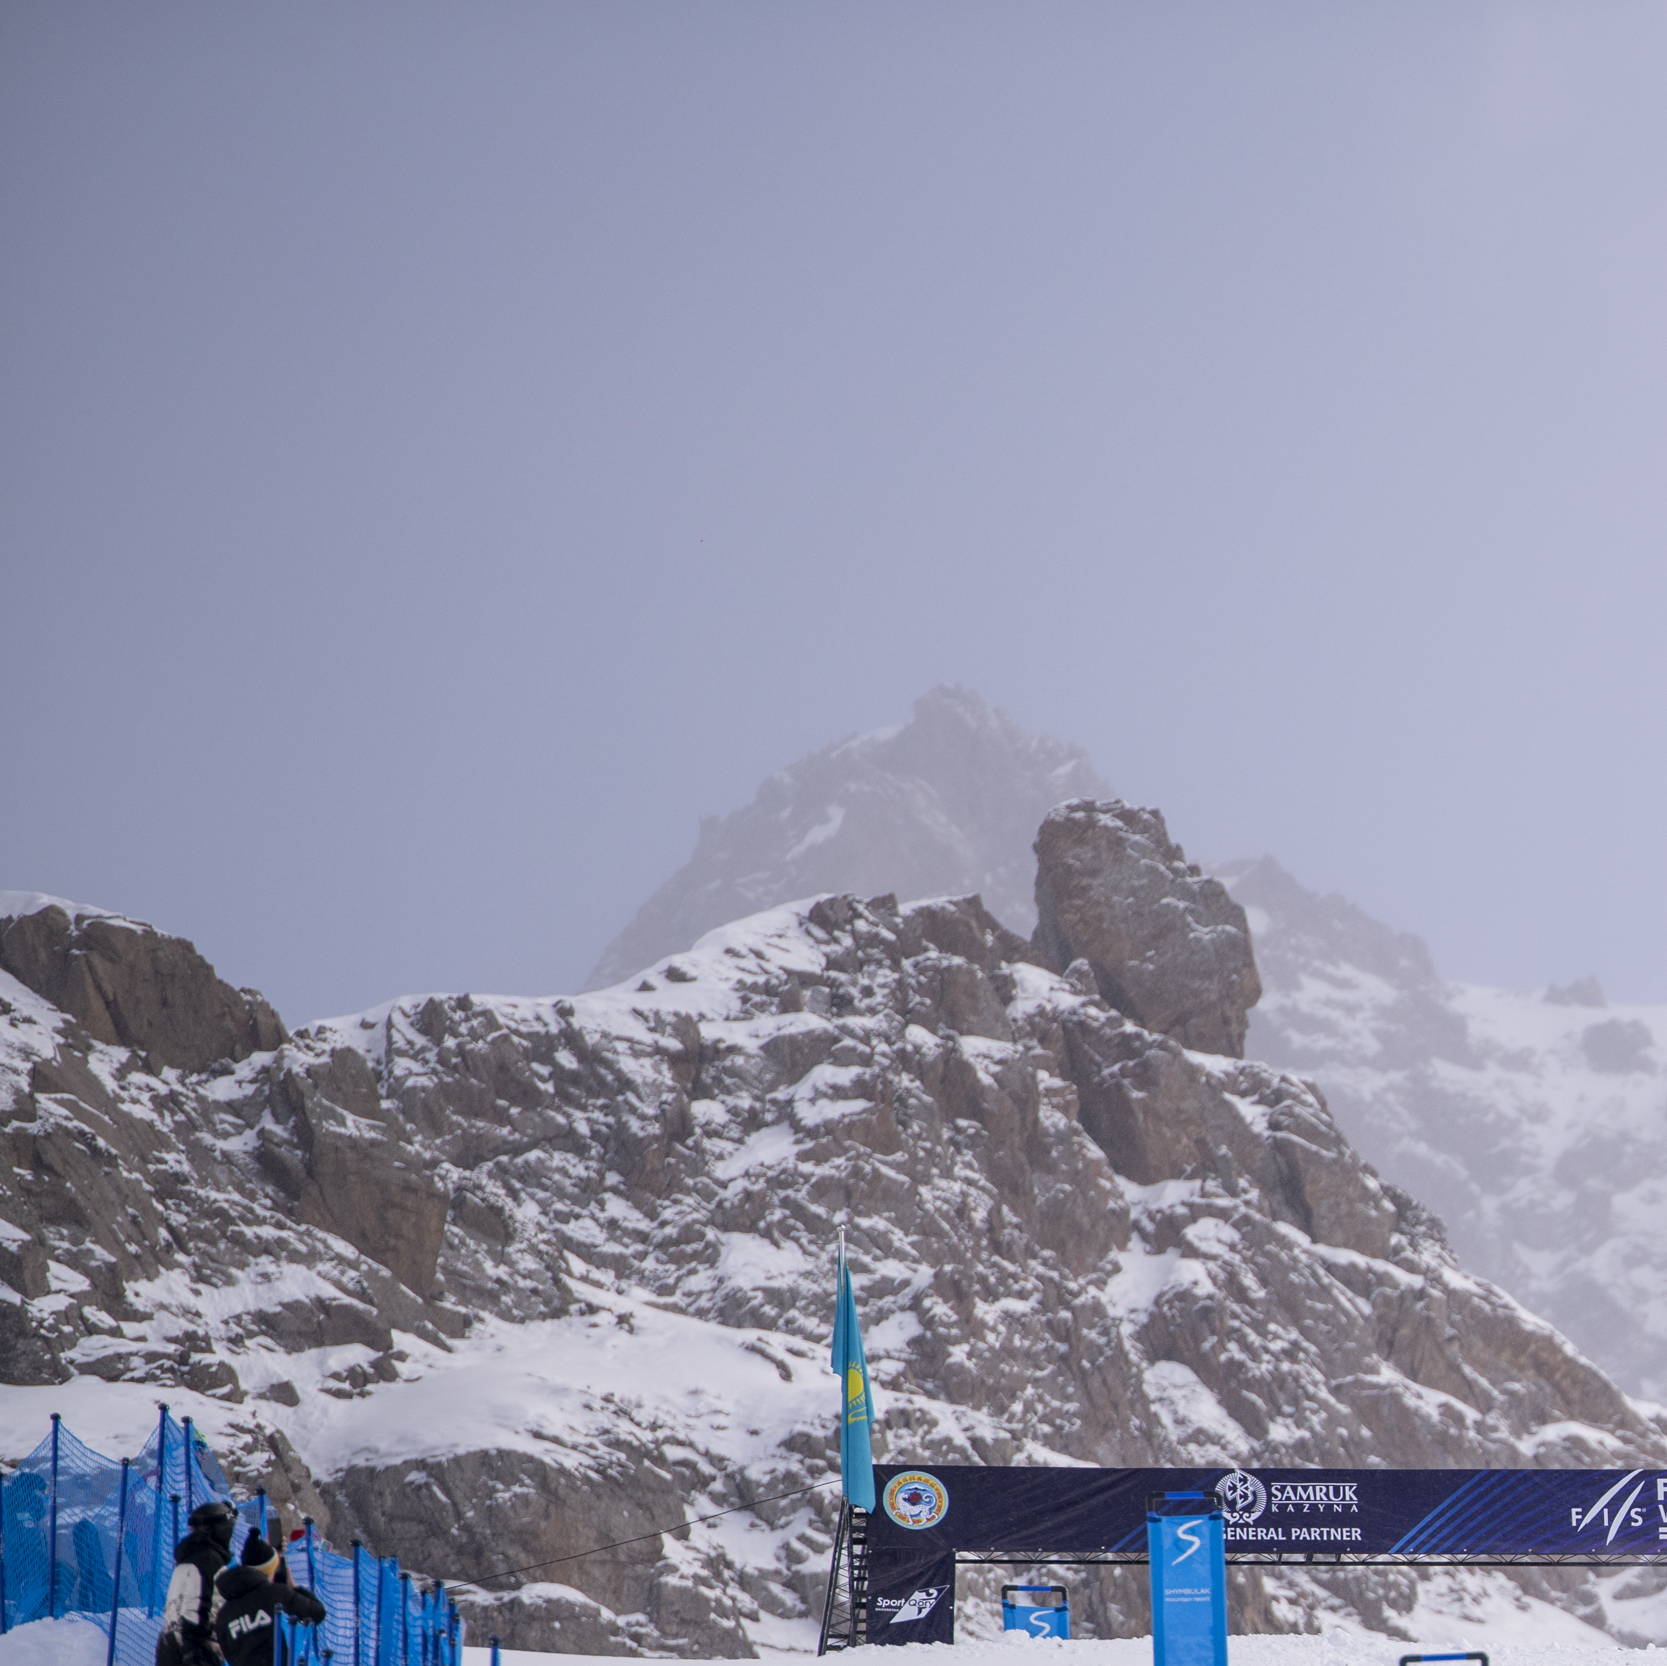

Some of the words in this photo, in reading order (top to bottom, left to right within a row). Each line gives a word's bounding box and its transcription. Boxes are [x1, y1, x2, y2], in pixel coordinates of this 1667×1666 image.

[1271, 1485, 1358, 1501] SAMRUK
[1271, 1503, 1359, 1513] KAZYNA
[1291, 1527, 1362, 1541] PARTNER
[876, 1597, 906, 1608] Sport
[228, 1609, 272, 1639] FILA
